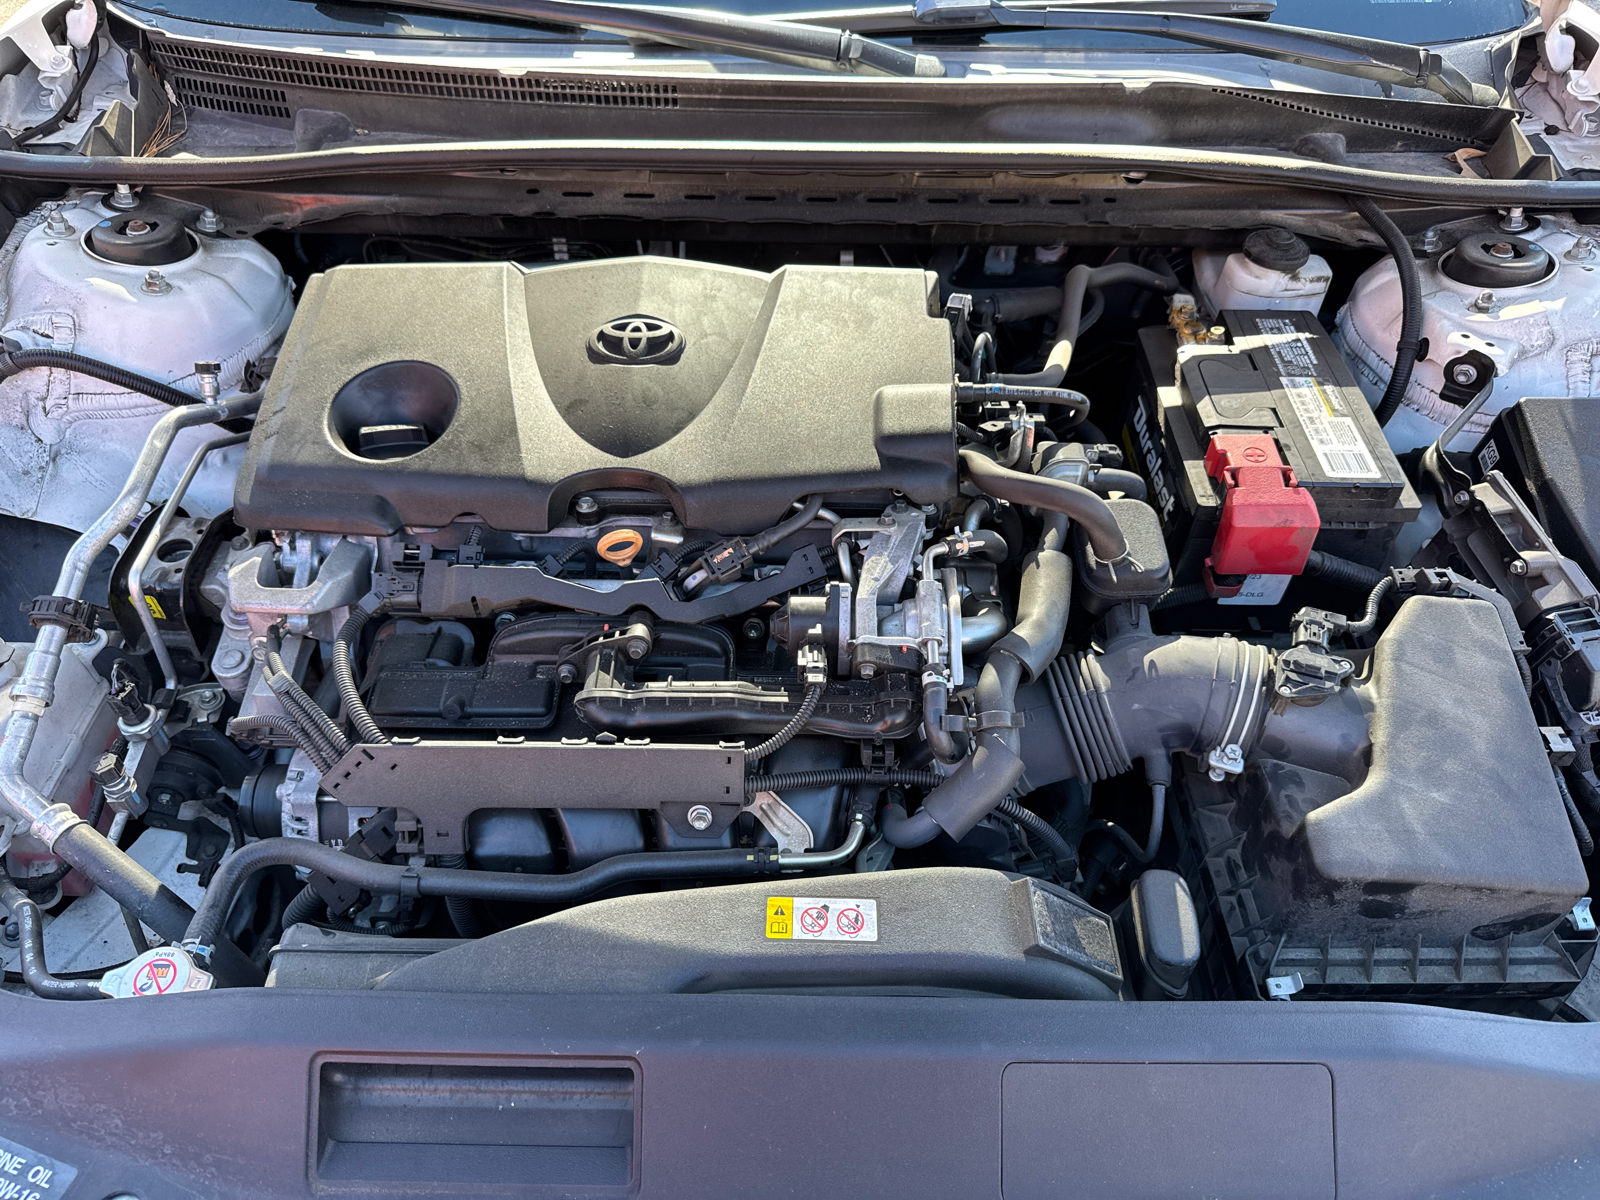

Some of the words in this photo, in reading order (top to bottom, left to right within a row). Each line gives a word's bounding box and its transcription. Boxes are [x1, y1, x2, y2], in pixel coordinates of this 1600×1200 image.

[1133, 394, 1175, 522] Duralast
[1485, 442, 1498, 465] KG9
[27, 1165, 53, 1189] OIL
